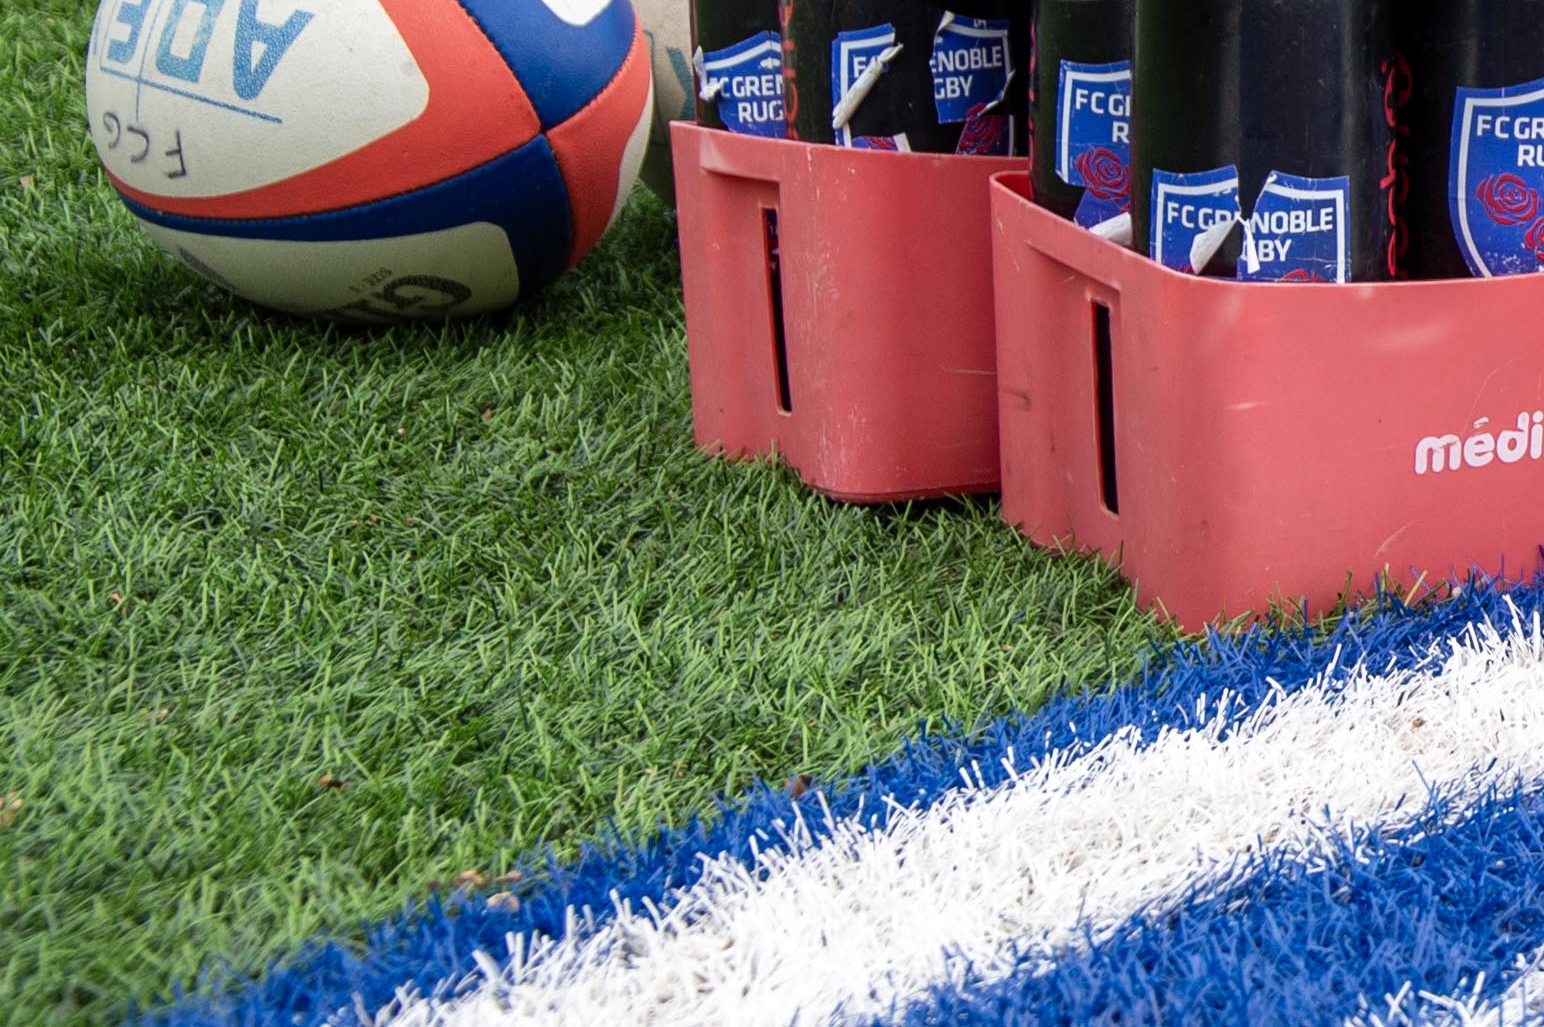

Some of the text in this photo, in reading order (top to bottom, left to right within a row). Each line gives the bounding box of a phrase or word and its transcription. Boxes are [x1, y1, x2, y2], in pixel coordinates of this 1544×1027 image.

[1075, 88, 1105, 115] FC
[1476, 114, 1510, 140] FC
[102, 111, 188, 180] FCG
[1166, 202, 1195, 230] FC
